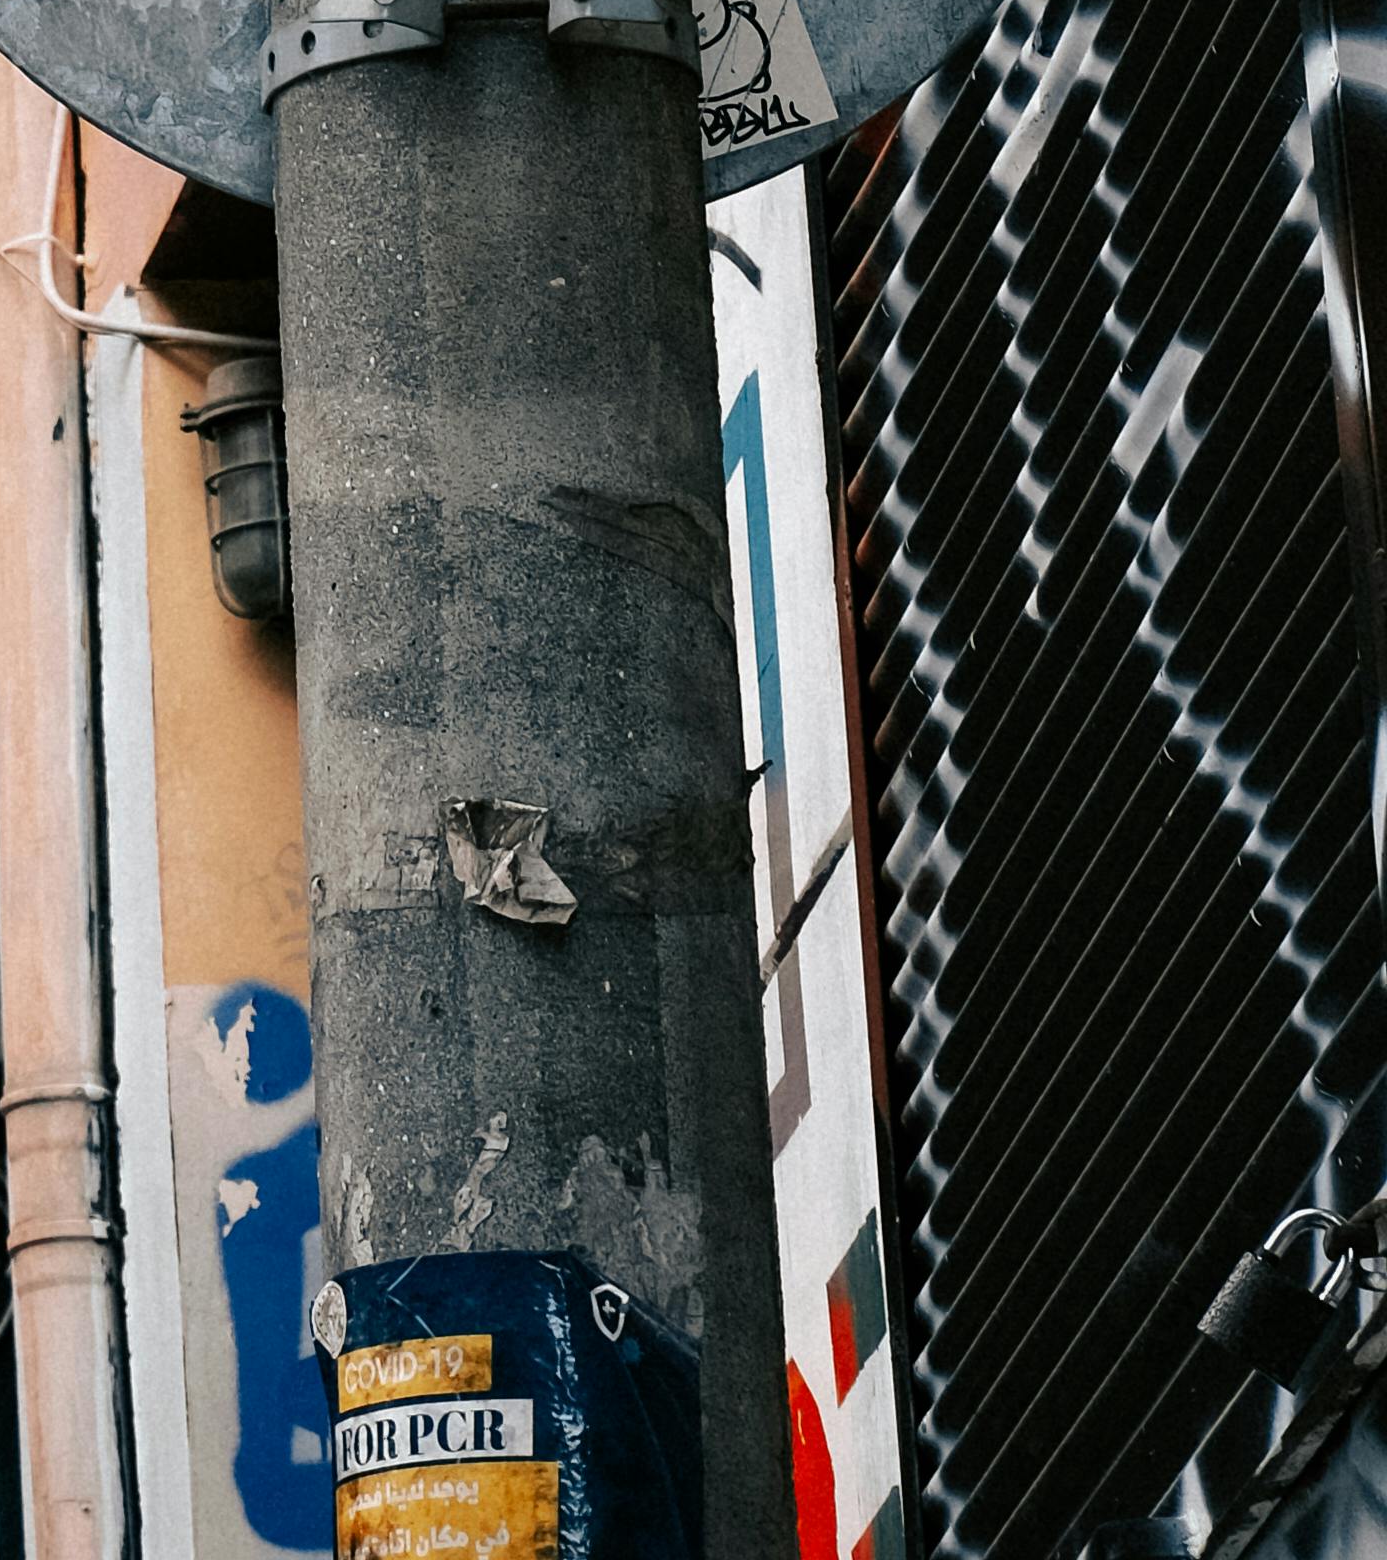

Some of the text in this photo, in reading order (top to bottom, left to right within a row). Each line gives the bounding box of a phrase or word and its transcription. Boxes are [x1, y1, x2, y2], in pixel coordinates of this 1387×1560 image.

[344, 1344, 465, 1395] COVID-19
[341, 1408, 507, 1472] FOR PCR
